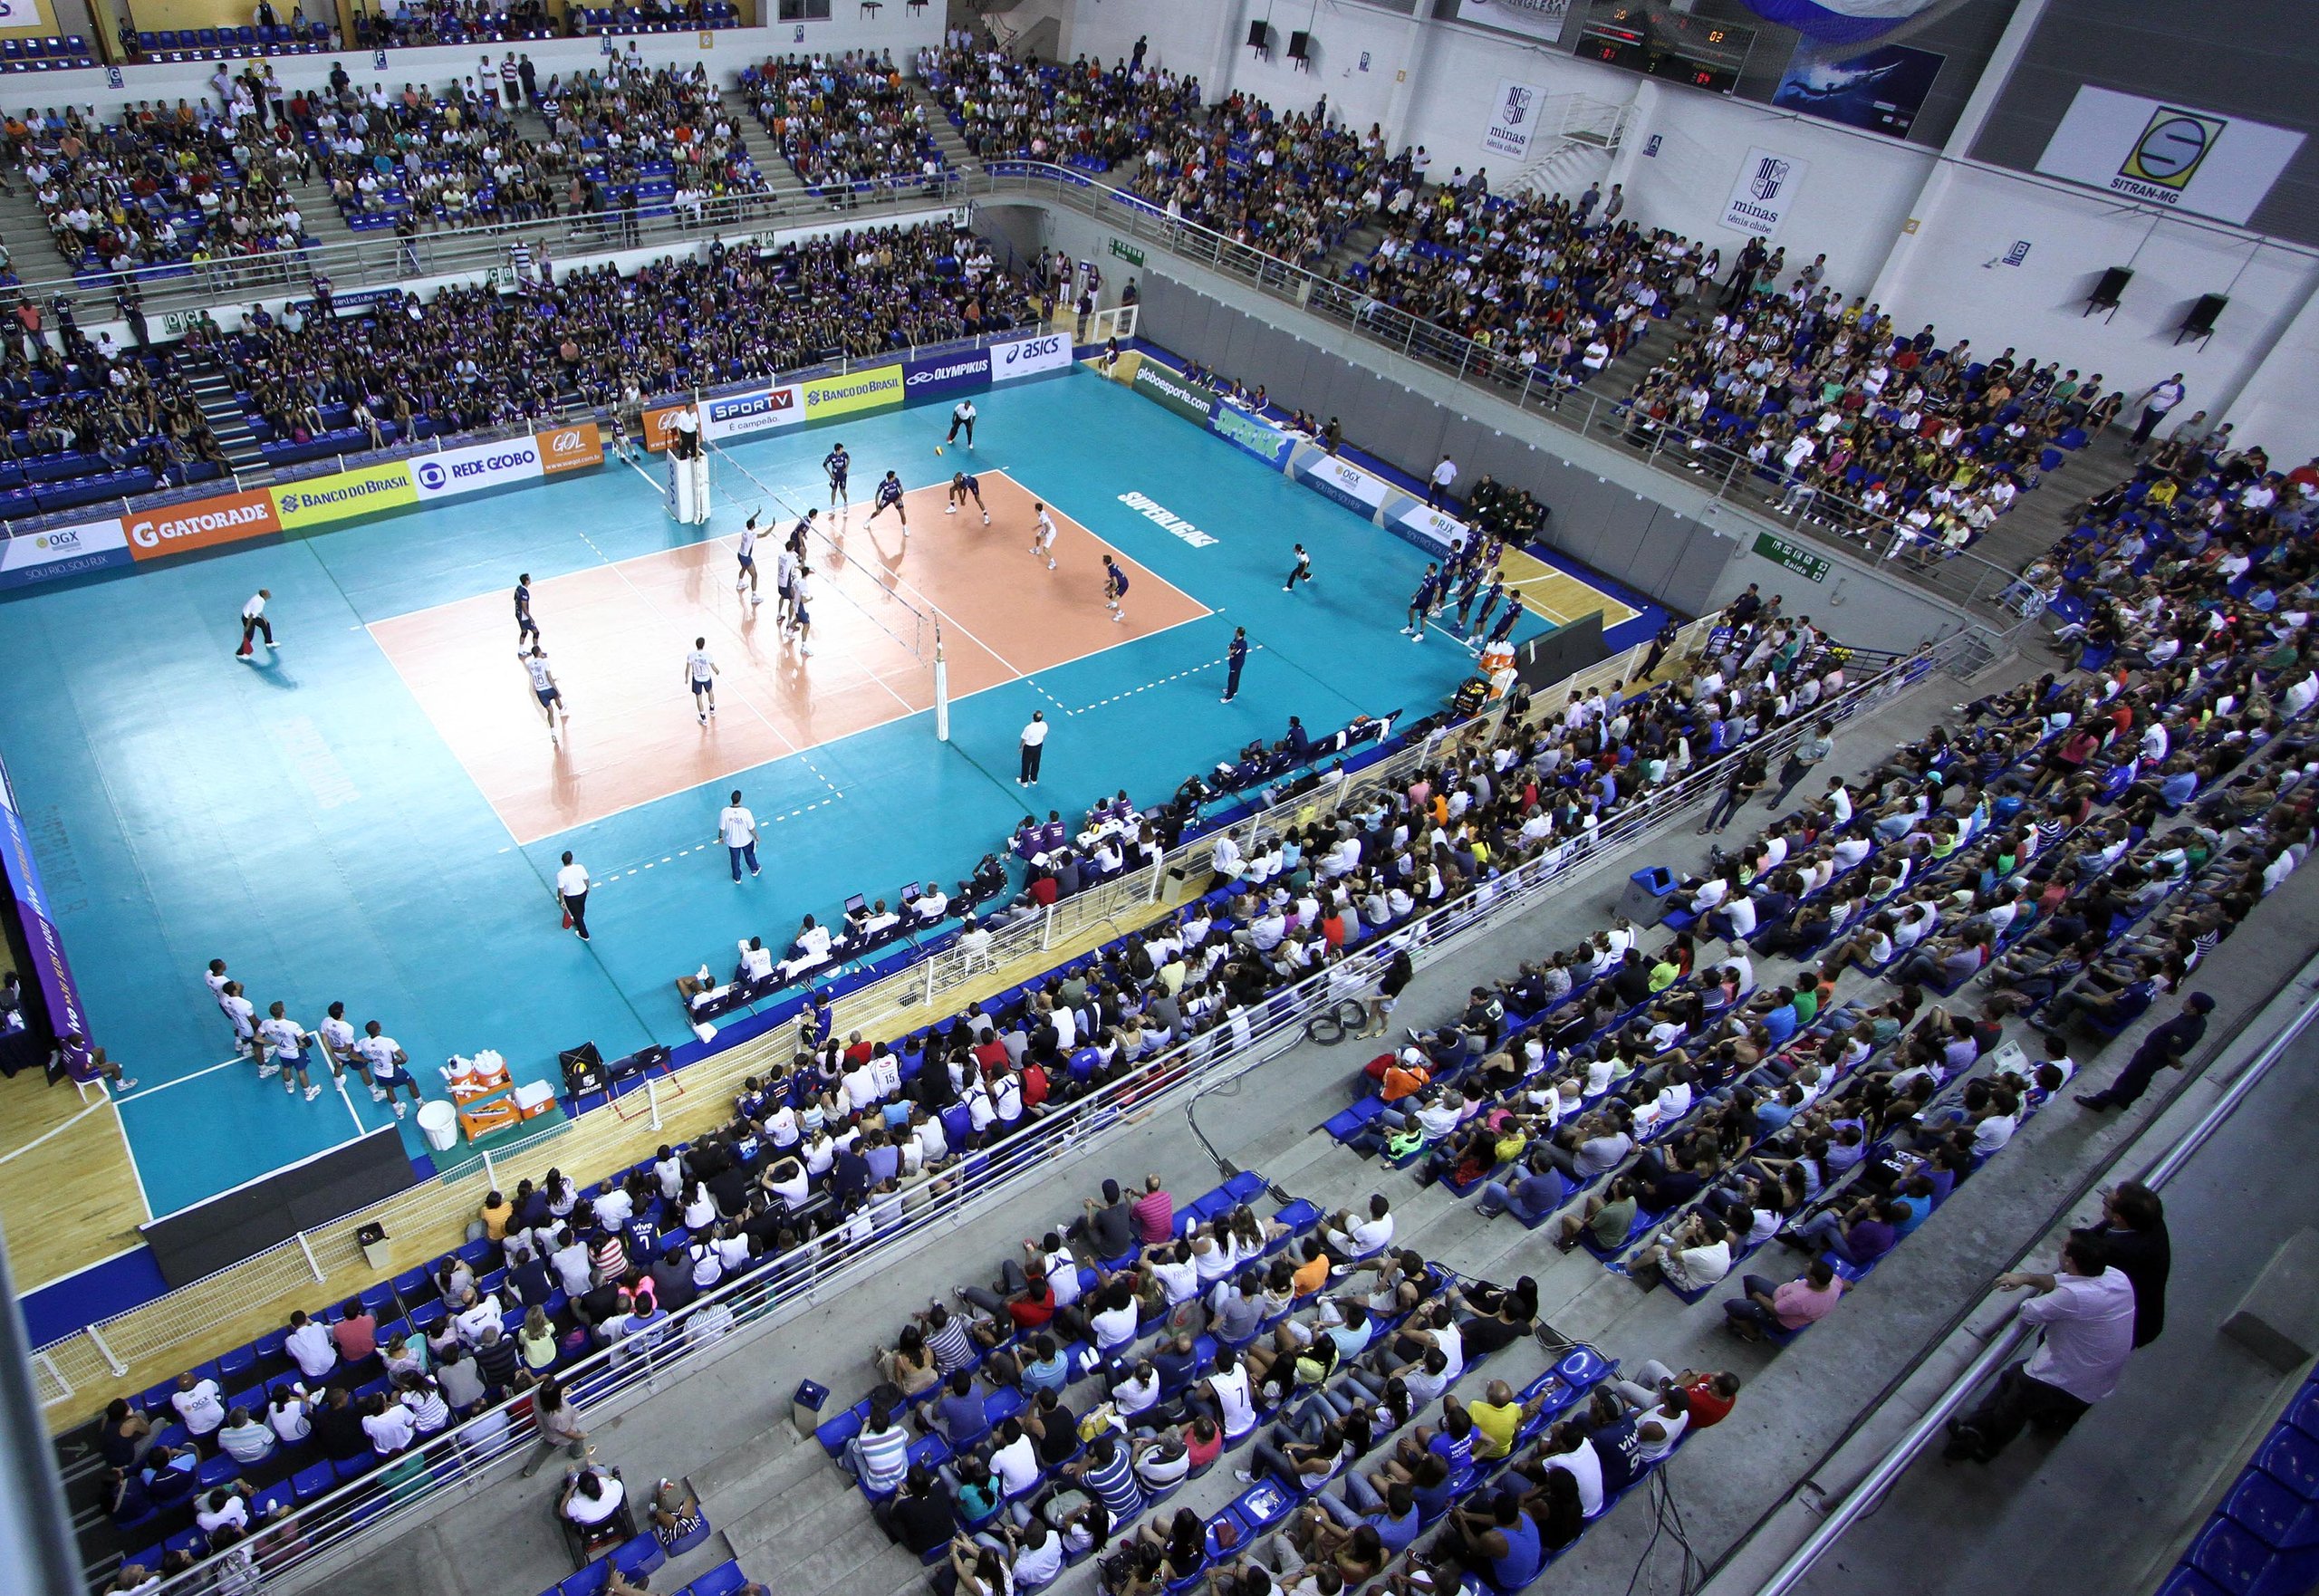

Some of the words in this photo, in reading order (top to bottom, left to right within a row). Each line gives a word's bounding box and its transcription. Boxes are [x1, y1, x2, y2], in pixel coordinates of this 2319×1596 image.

[110, 68, 120, 80] G
[1489, 125, 1526, 145] minas
[1504, 144, 1522, 156] clube
[2110, 178, 2179, 205] SITRAN-MG
[1731, 199, 1778, 223] minas
[1749, 221, 1772, 235] clube
[2014, 244, 2027, 256] B
[1023, 337, 1059, 359] asics
[934, 360, 988, 380] OLYMPIKUS
[823, 386, 854, 401] BANCO
[855, 382, 868, 394] DO
[869, 377, 900, 391] BRASIL
[1136, 367, 1210, 414] globoesporte.com
[715, 393, 789, 418] SPORTV
[728, 422, 736, 431] É
[737, 416, 780, 429] campeão.
[553, 430, 584, 453] GOL
[451, 460, 486, 478] REDE
[486, 449, 535, 471] GLOBO
[1342, 468, 1362, 484] OGX
[301, 488, 348, 509] BANCO
[349, 484, 365, 496] DO
[366, 474, 410, 495] BRASIL
[132, 521, 159, 548] G
[159, 505, 268, 539] GATORADE
[1117, 492, 1219, 548] SUPERLIGA
[1438, 518, 1457, 534] RJX
[49, 531, 79, 545] OGX
[25, 568, 48, 581] SOU
[68, 556, 91, 571] SOU
[90, 554, 109, 566] RJX
[534, 674, 544, 686] 18
[26, 885, 43, 917] vivo
[577, 1082, 602, 1095] minas
[885, 1072, 897, 1085] 15
[632, 1223, 653, 1233] vivo
[639, 1235, 650, 1250] 7
[191, 1396, 209, 1409] OGX
[1235, 1386, 1244, 1408] 7
[1629, 1453, 1640, 1476] 9
